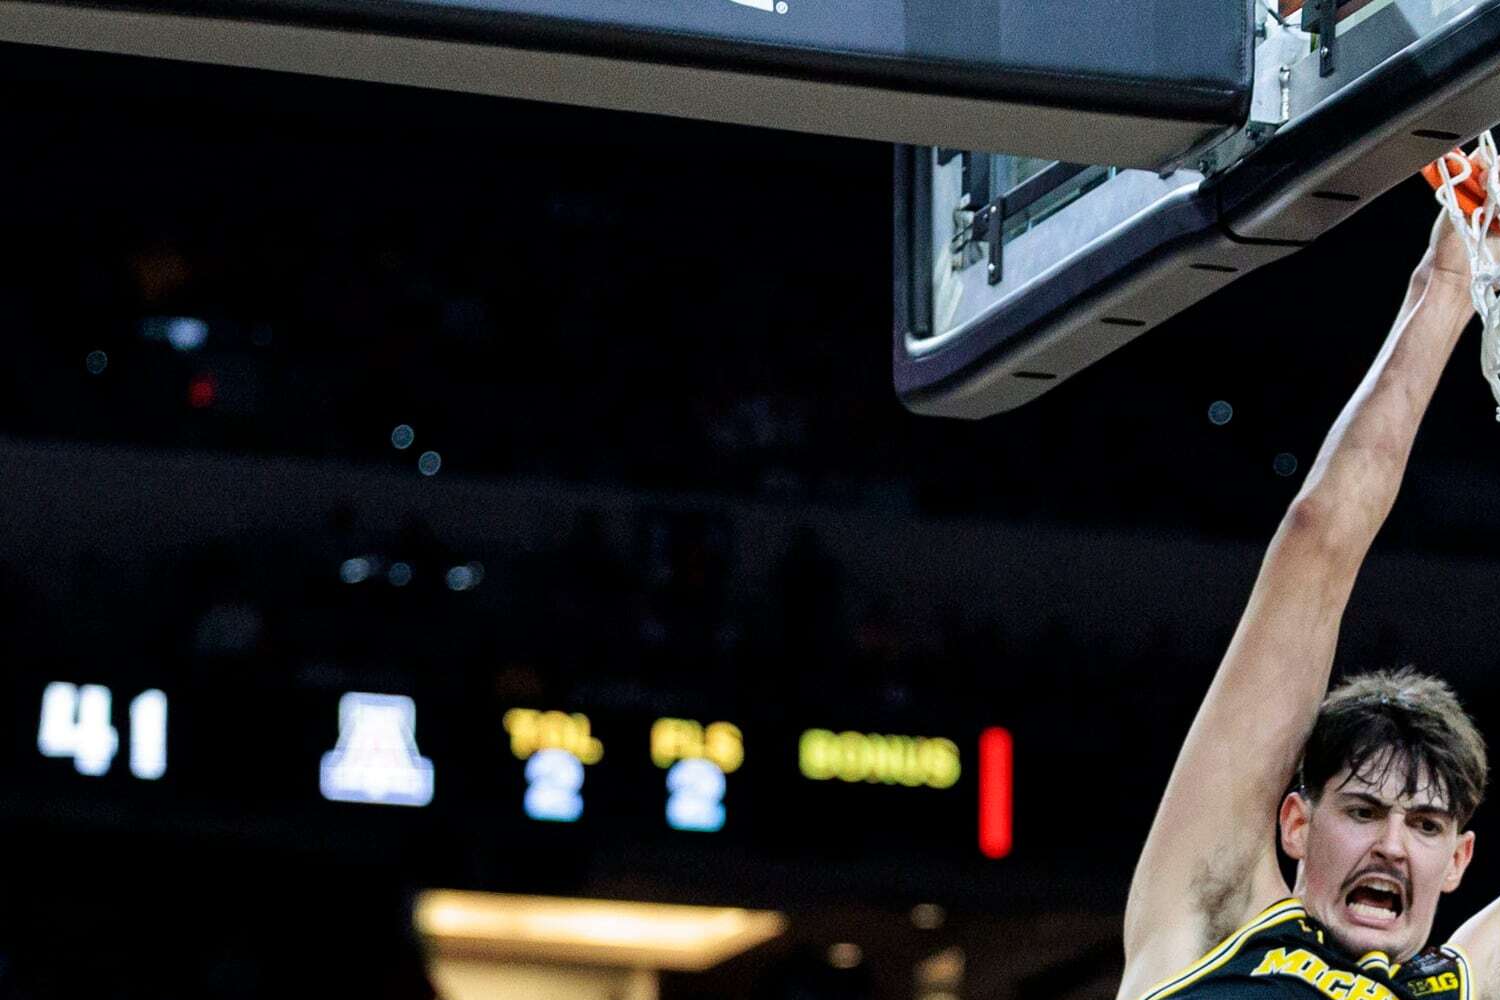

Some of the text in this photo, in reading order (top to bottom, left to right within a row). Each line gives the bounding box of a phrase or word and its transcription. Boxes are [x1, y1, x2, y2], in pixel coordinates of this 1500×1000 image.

[38, 682, 168, 779] 41
[523, 749, 585, 822] 2
[666, 758, 726, 832] 2
